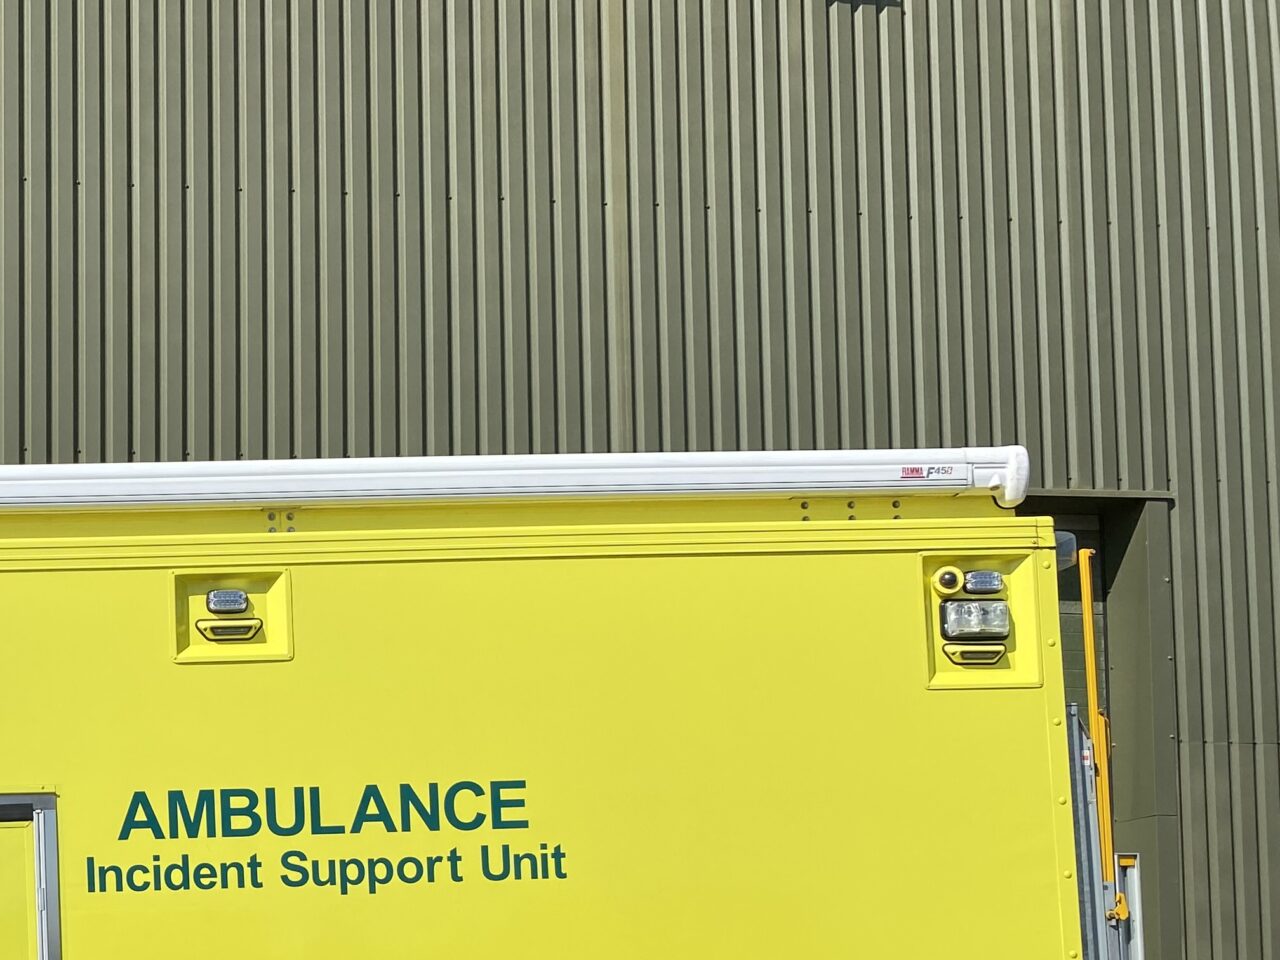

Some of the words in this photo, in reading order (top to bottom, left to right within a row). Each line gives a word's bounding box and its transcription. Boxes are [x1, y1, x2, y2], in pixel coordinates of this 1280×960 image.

[117, 779, 530, 841] AMBULANCE
[86, 852, 264, 893] Incident
[280, 846, 463, 895] Support
[480, 843, 567, 881] Unit
